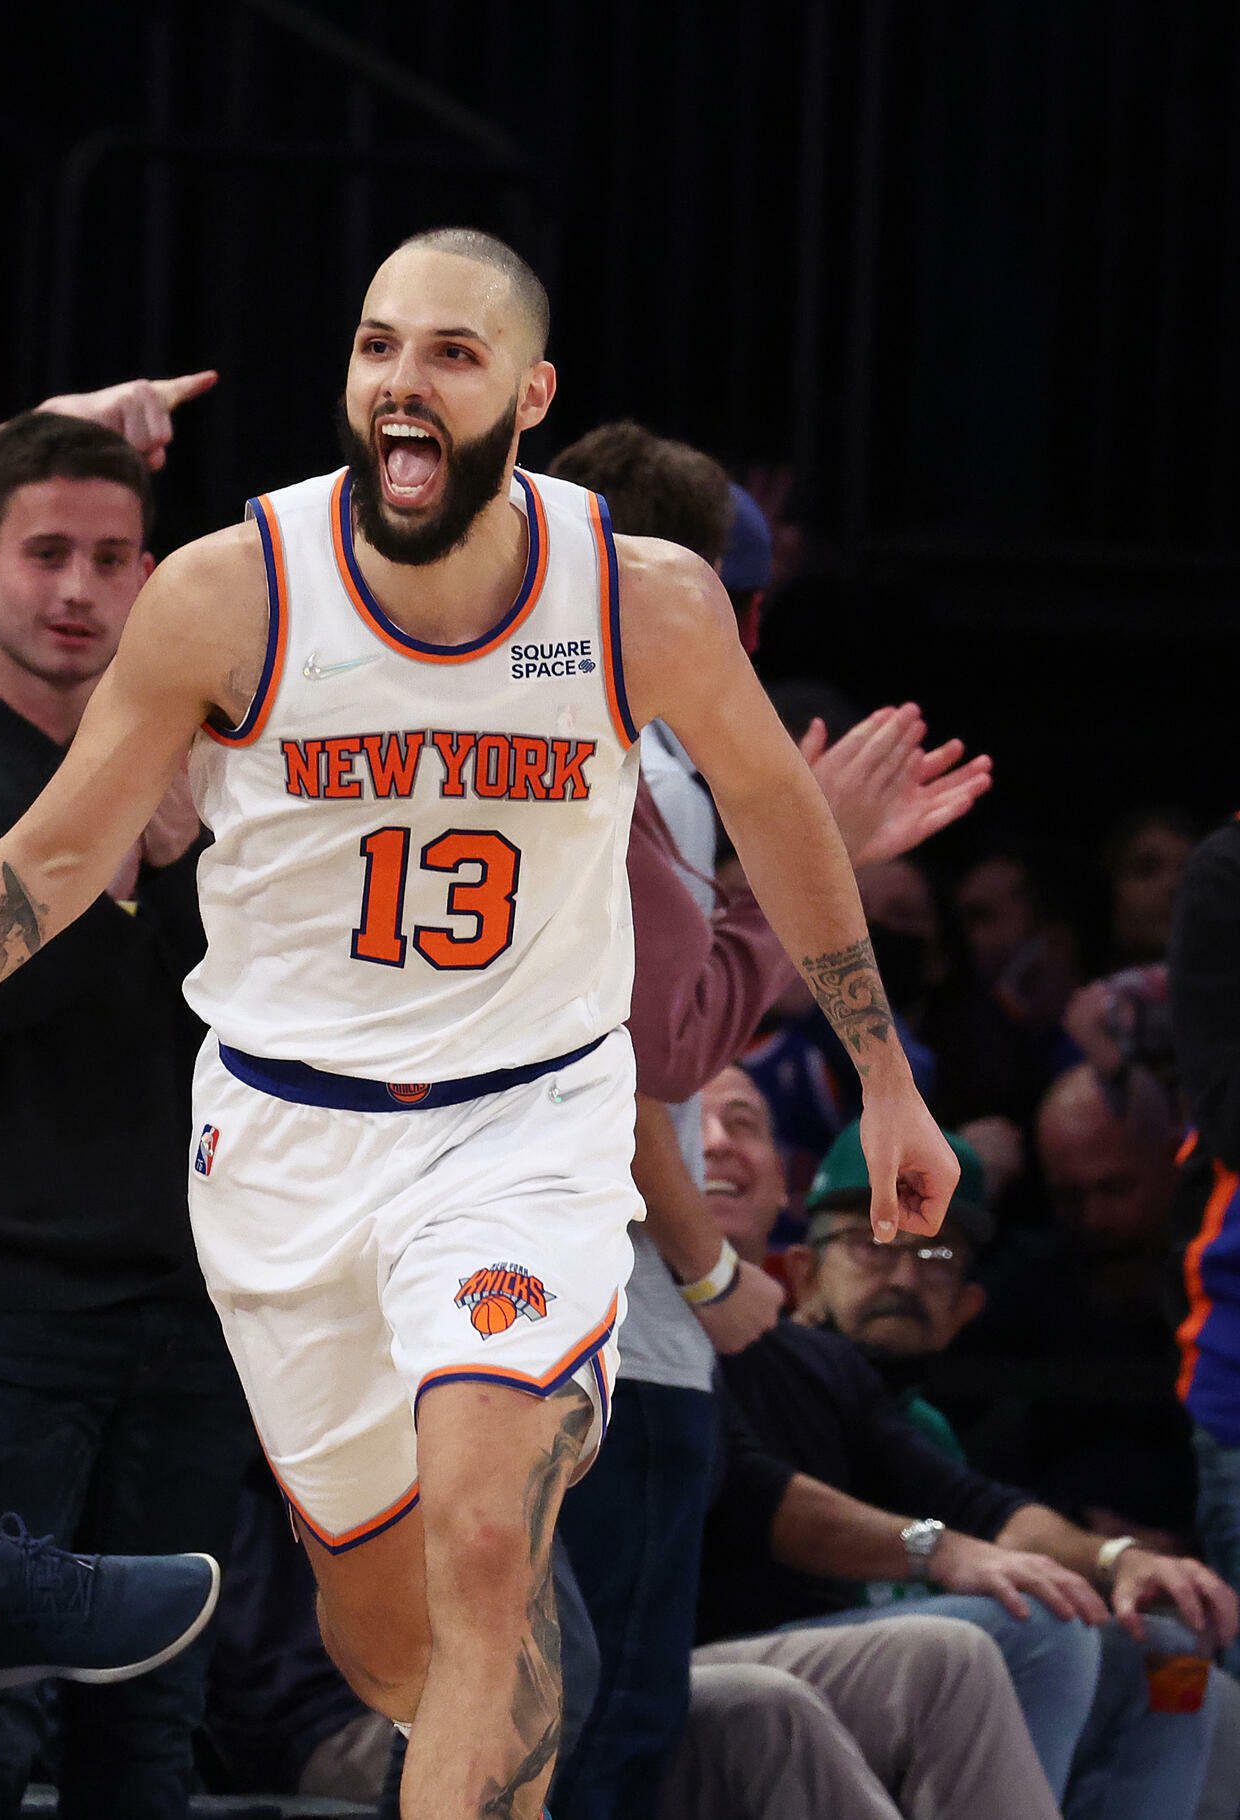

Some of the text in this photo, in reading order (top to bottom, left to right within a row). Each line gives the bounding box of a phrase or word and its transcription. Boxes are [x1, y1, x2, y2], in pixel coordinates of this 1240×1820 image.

[511, 640, 592, 661] SQUARE
[511, 660, 576, 679] SPACE
[281, 729, 597, 802] NEW YORK
[350, 826, 522, 970] 13
[454, 1267, 547, 1318] KNICKS
